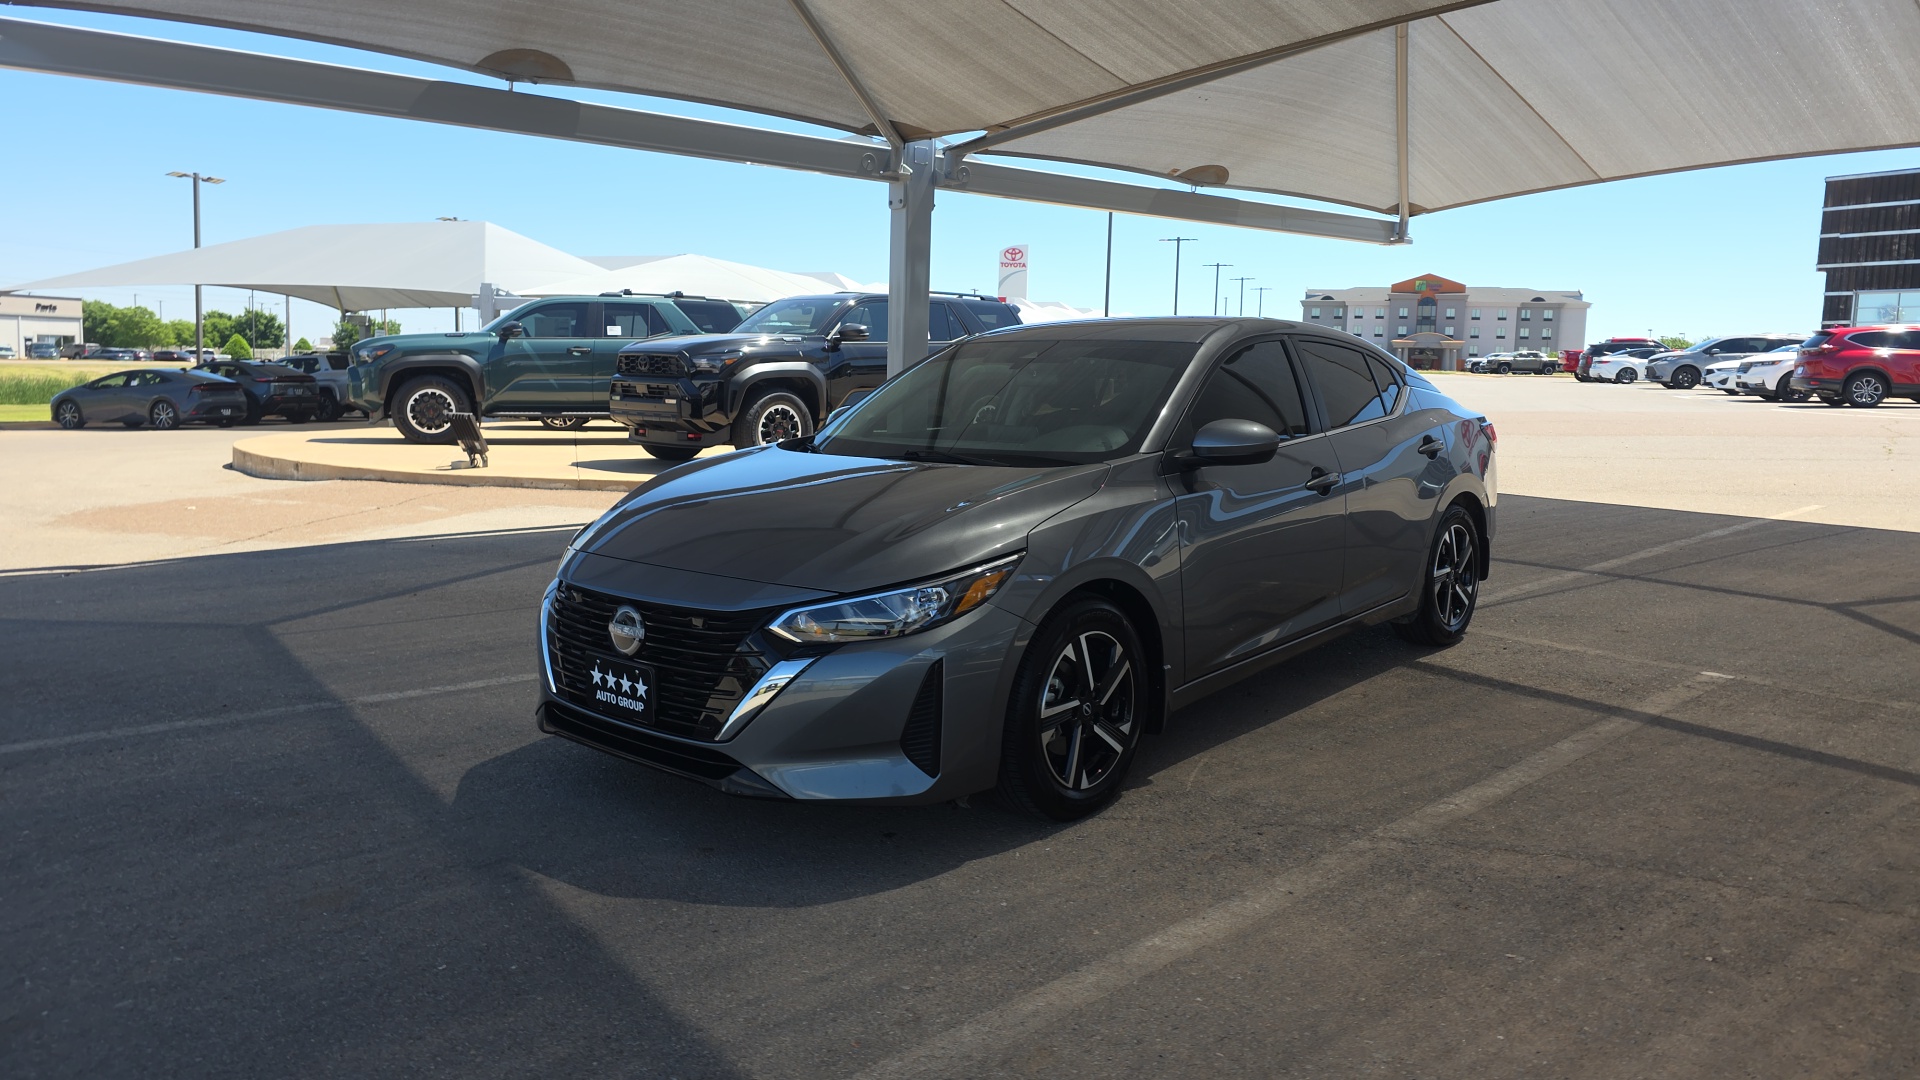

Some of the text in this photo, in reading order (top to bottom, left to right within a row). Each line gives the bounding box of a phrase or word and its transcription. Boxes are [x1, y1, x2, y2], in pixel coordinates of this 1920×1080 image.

[610, 625, 642, 638] NISSAN
[596, 690, 644, 712] AUTO GROUP
